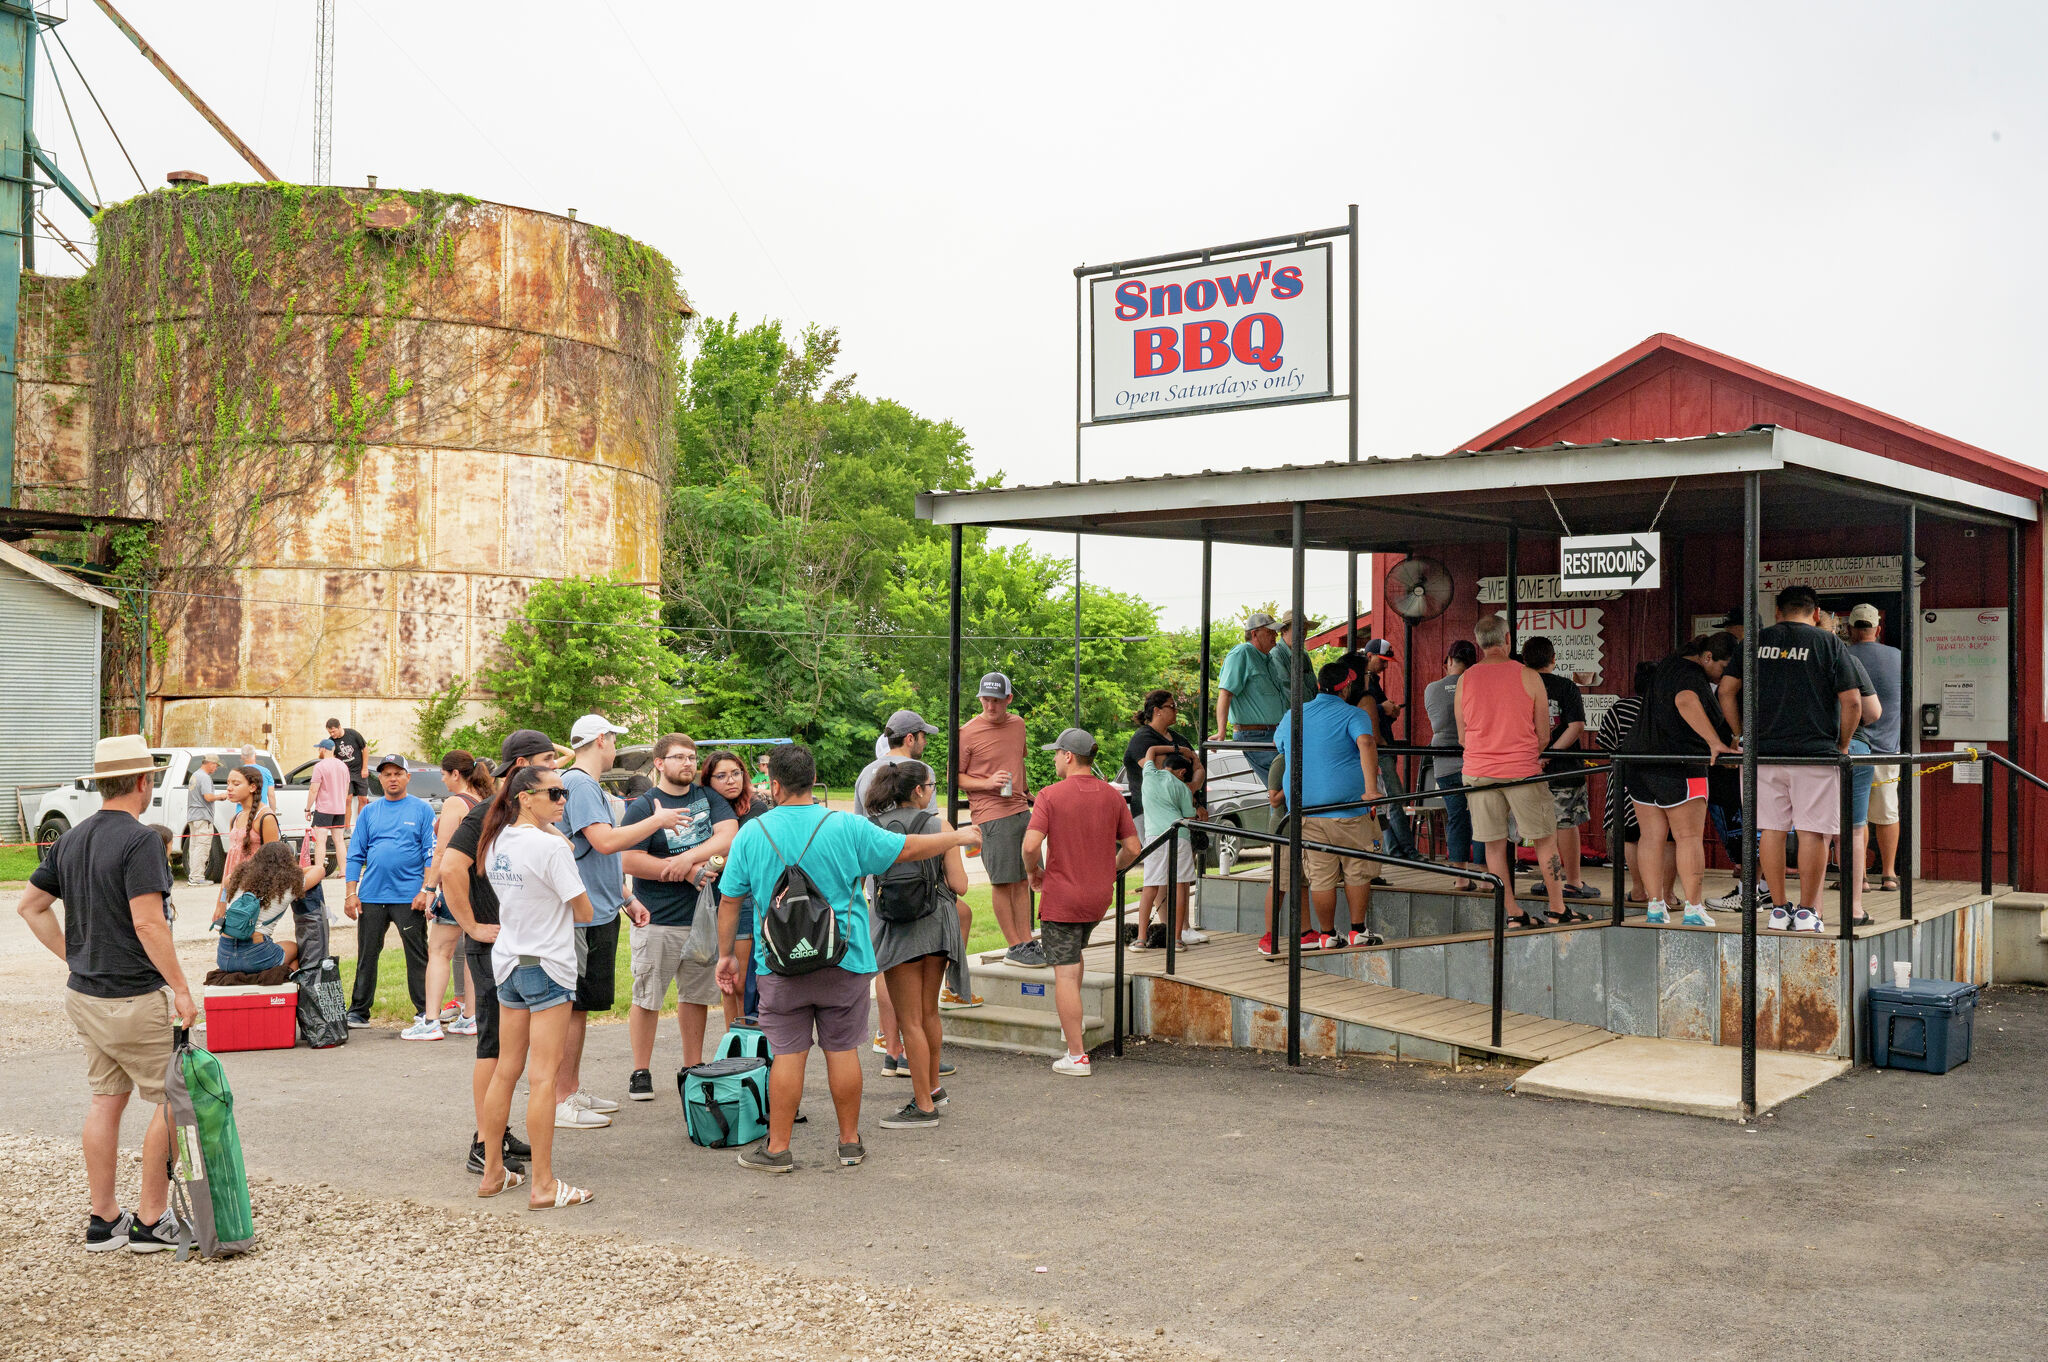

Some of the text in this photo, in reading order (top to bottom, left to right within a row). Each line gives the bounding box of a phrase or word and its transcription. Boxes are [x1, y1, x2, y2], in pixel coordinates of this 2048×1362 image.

[1114, 259, 1305, 322] Snow's
[1133, 312, 1284, 379] BBQ
[1115, 368, 1305, 411] Open Saturdays only
[1564, 550, 1646, 575] RESTROOMS
[1776, 561, 1794, 572] KEEP
[1796, 560, 1812, 572] THIS
[1814, 560, 1834, 571] DOOR
[1835, 558, 1864, 570] CLOSED
[1866, 558, 1874, 569] AT
[1877, 556, 1890, 568] ALL
[1488, 578, 1544, 600] WEOME
[1776, 578, 1786, 590] DO
[1805, 576, 1826, 588] BLOCK
[1828, 575, 1864, 587] DOORWAY
[1566, 634, 1596, 647] CHICKEN,
[1566, 650, 1594, 660] SAUSAGE
[489, 872, 522, 882] REEN MAN
[790, 949, 818, 959] adidas
